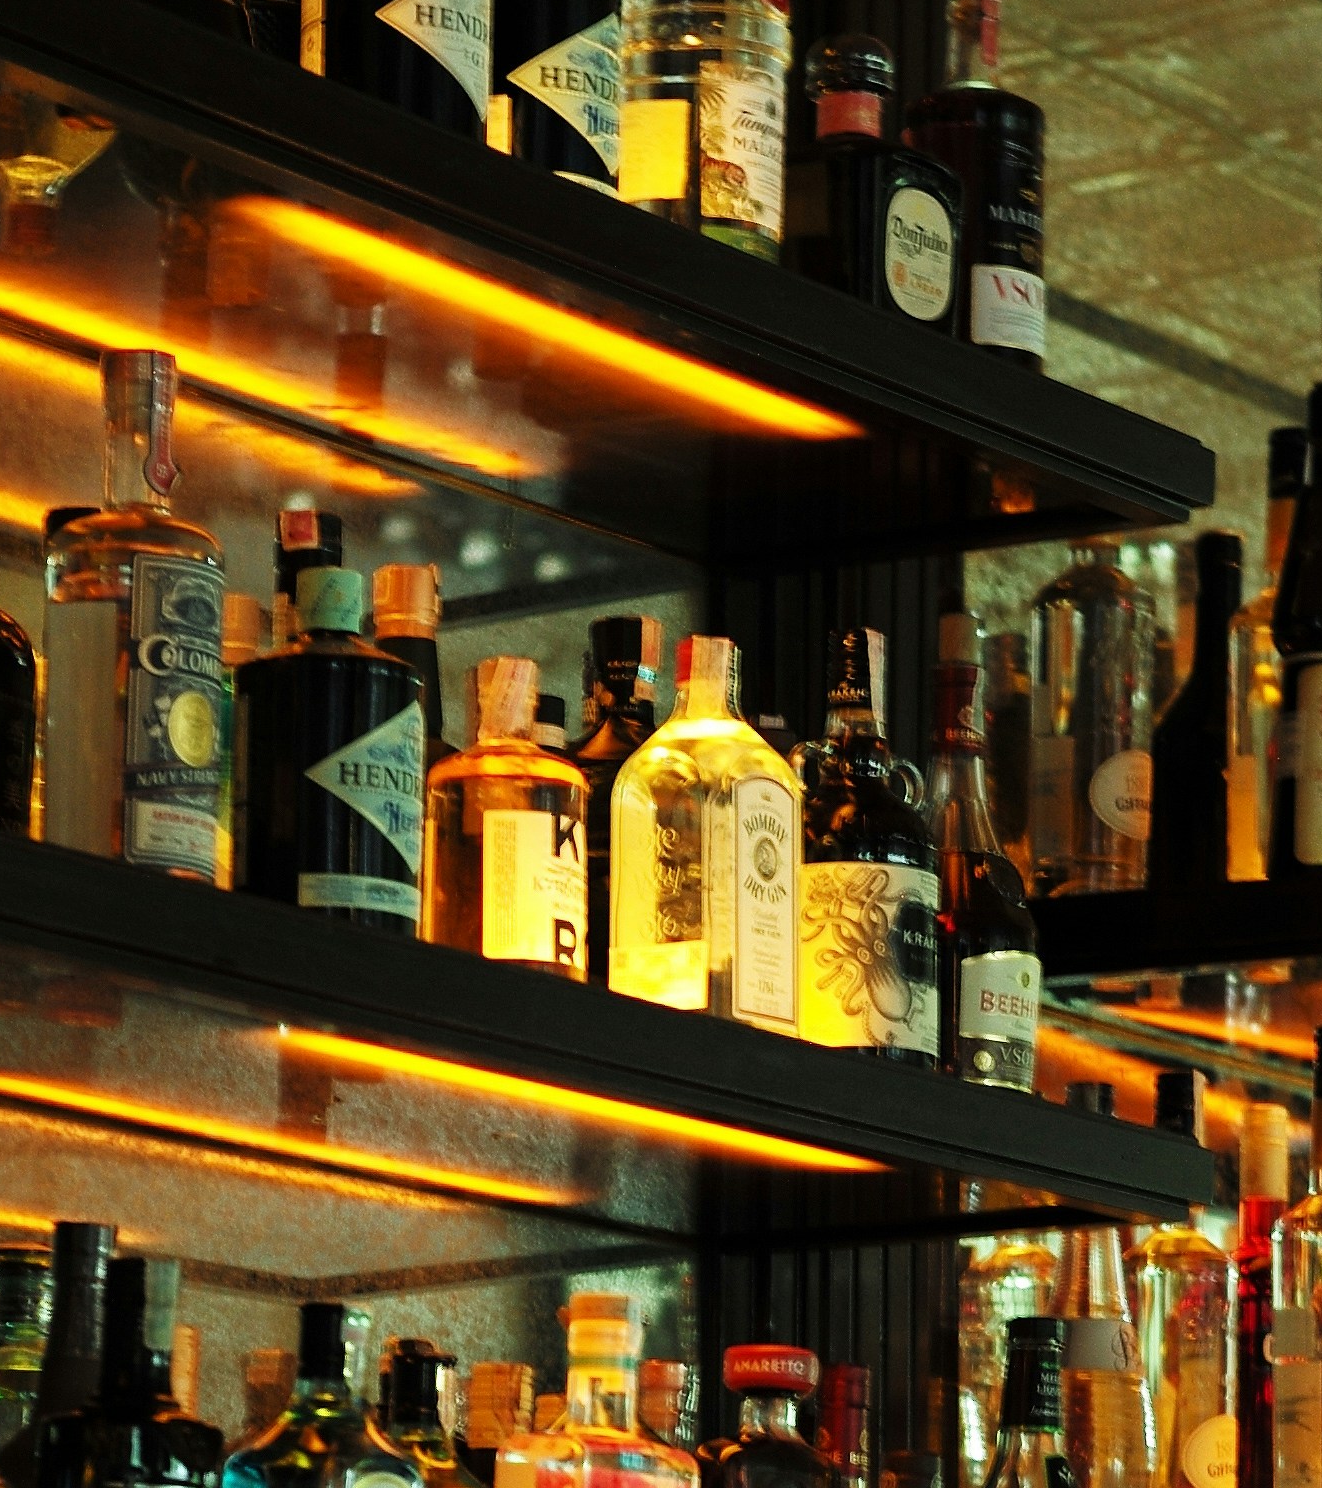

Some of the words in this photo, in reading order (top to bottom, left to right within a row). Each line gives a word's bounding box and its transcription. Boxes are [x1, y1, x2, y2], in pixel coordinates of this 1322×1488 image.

[742, 812, 788, 843] BOMBAY
[743, 873, 766, 903] DRY
[766, 883, 788, 905] GIN
[733, 1359, 805, 1376] AMARETTO
